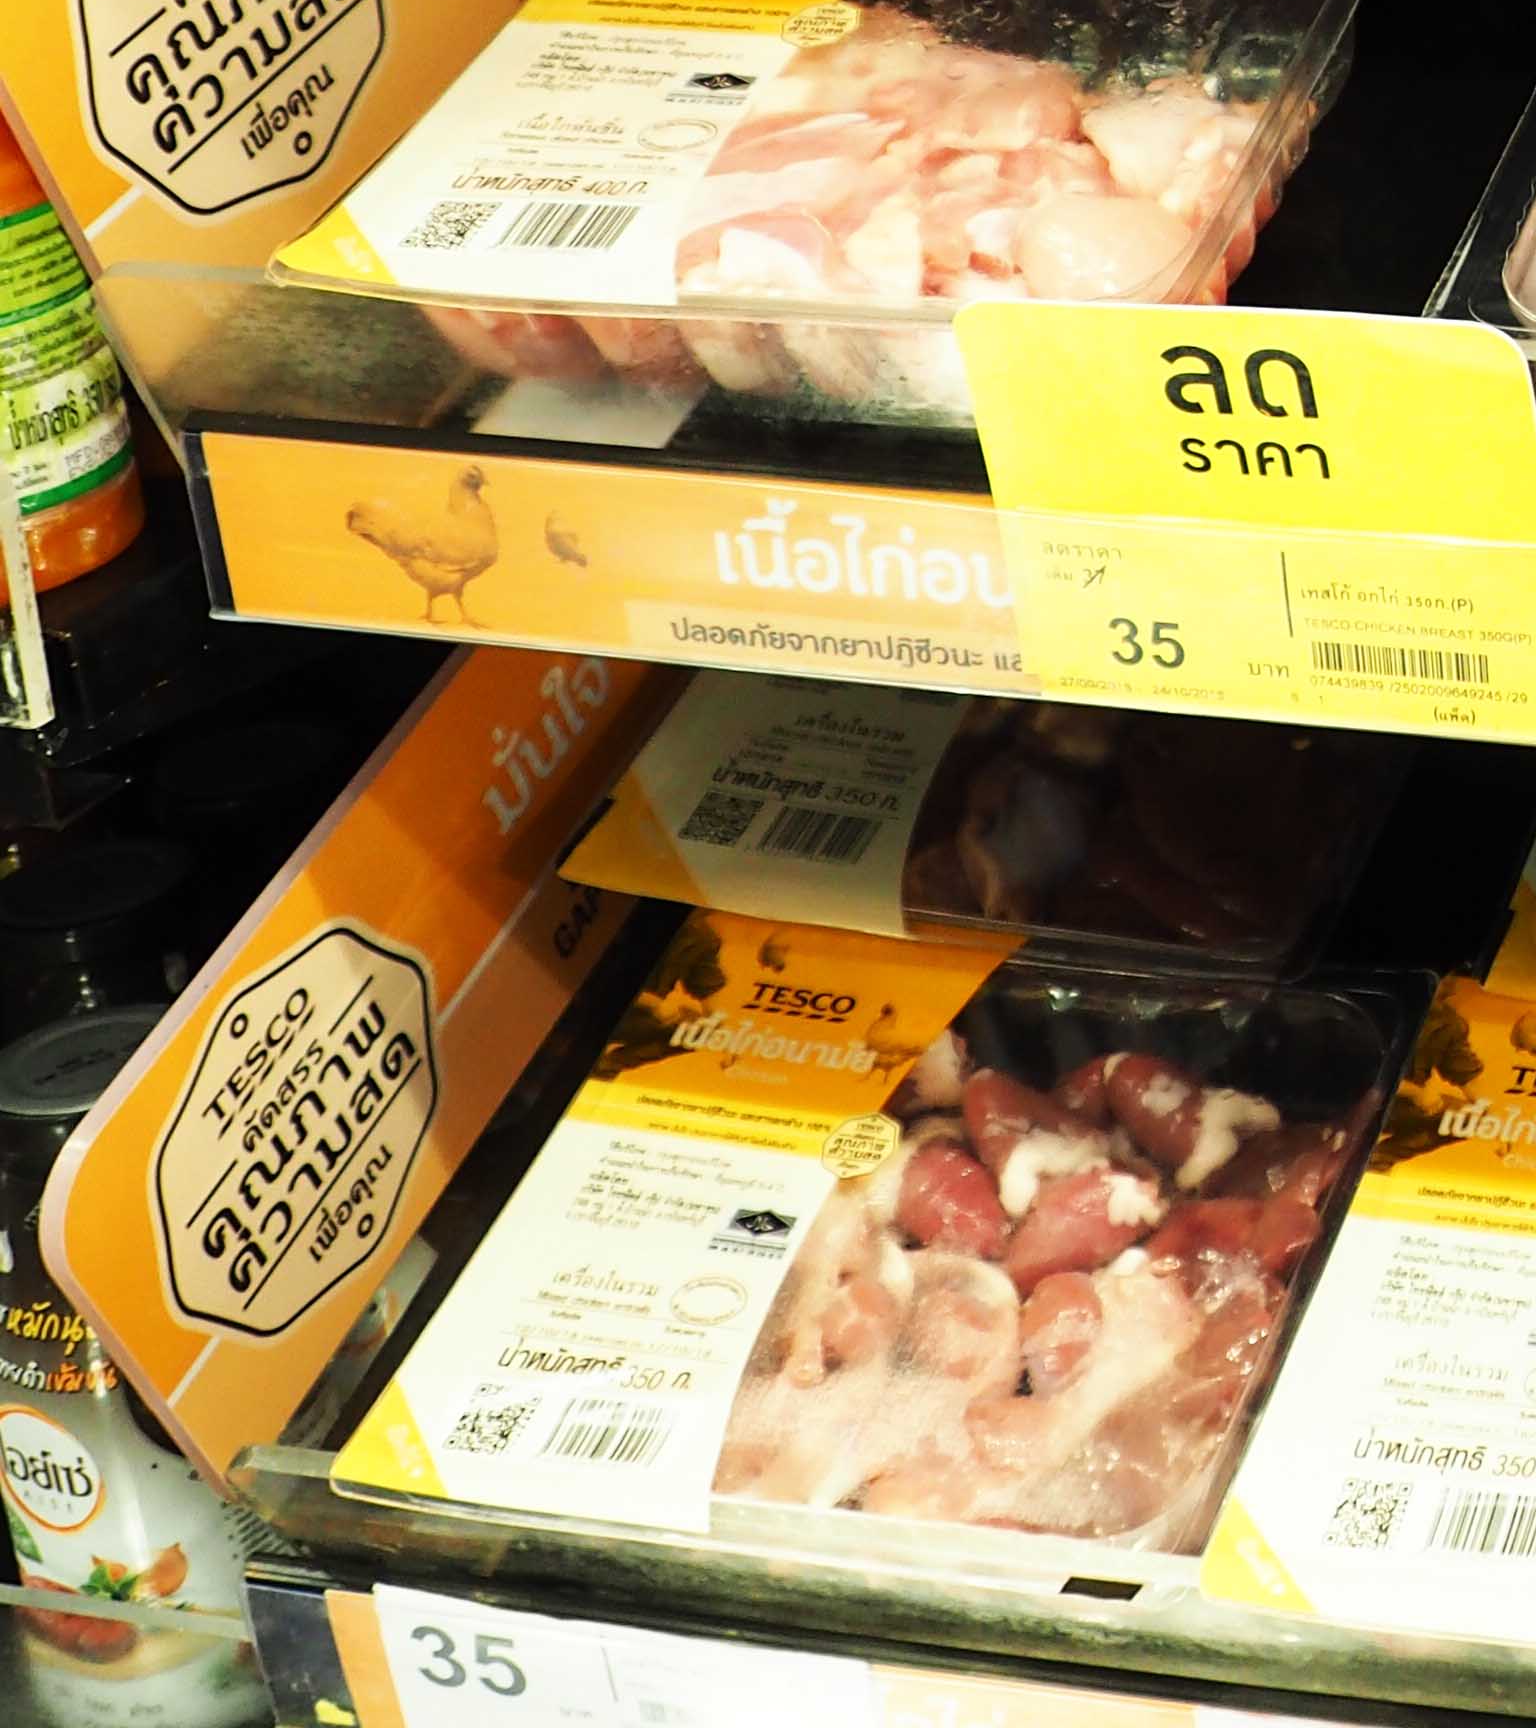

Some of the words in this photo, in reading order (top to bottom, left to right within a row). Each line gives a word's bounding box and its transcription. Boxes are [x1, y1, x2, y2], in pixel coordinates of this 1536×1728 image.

[240, 64, 334, 160] เพื่อคุณ
[1160, 344, 1320, 419] ลด
[1181, 437, 1332, 480] ราคา
[1300, 583, 1351, 600] เทสโก้
[1108, 617, 1185, 669] 35
[1305, 618, 1351, 631] TESCO
[1355, 621, 1416, 636] CHICKEN
[1421, 626, 1473, 641] BREAST
[1247, 660, 1290, 679] บาท
[825, 786, 876, 809] 350
[754, 983, 855, 1014] TESCO
[201, 987, 309, 1122] TESCO
[240, 1042, 325, 1152] คัดสรร
[201, 1000, 386, 1259] คุณภาพ
[228, 1030, 416, 1293] ความสด
[309, 1144, 393, 1263] เพื่อคุณ
[619, 1364, 666, 1390] 350
[1354, 1428, 1488, 1476] น้ำหนักสุทธิ
[1492, 1453, 1536, 1478] 350
[410, 1625, 528, 1698] 35
